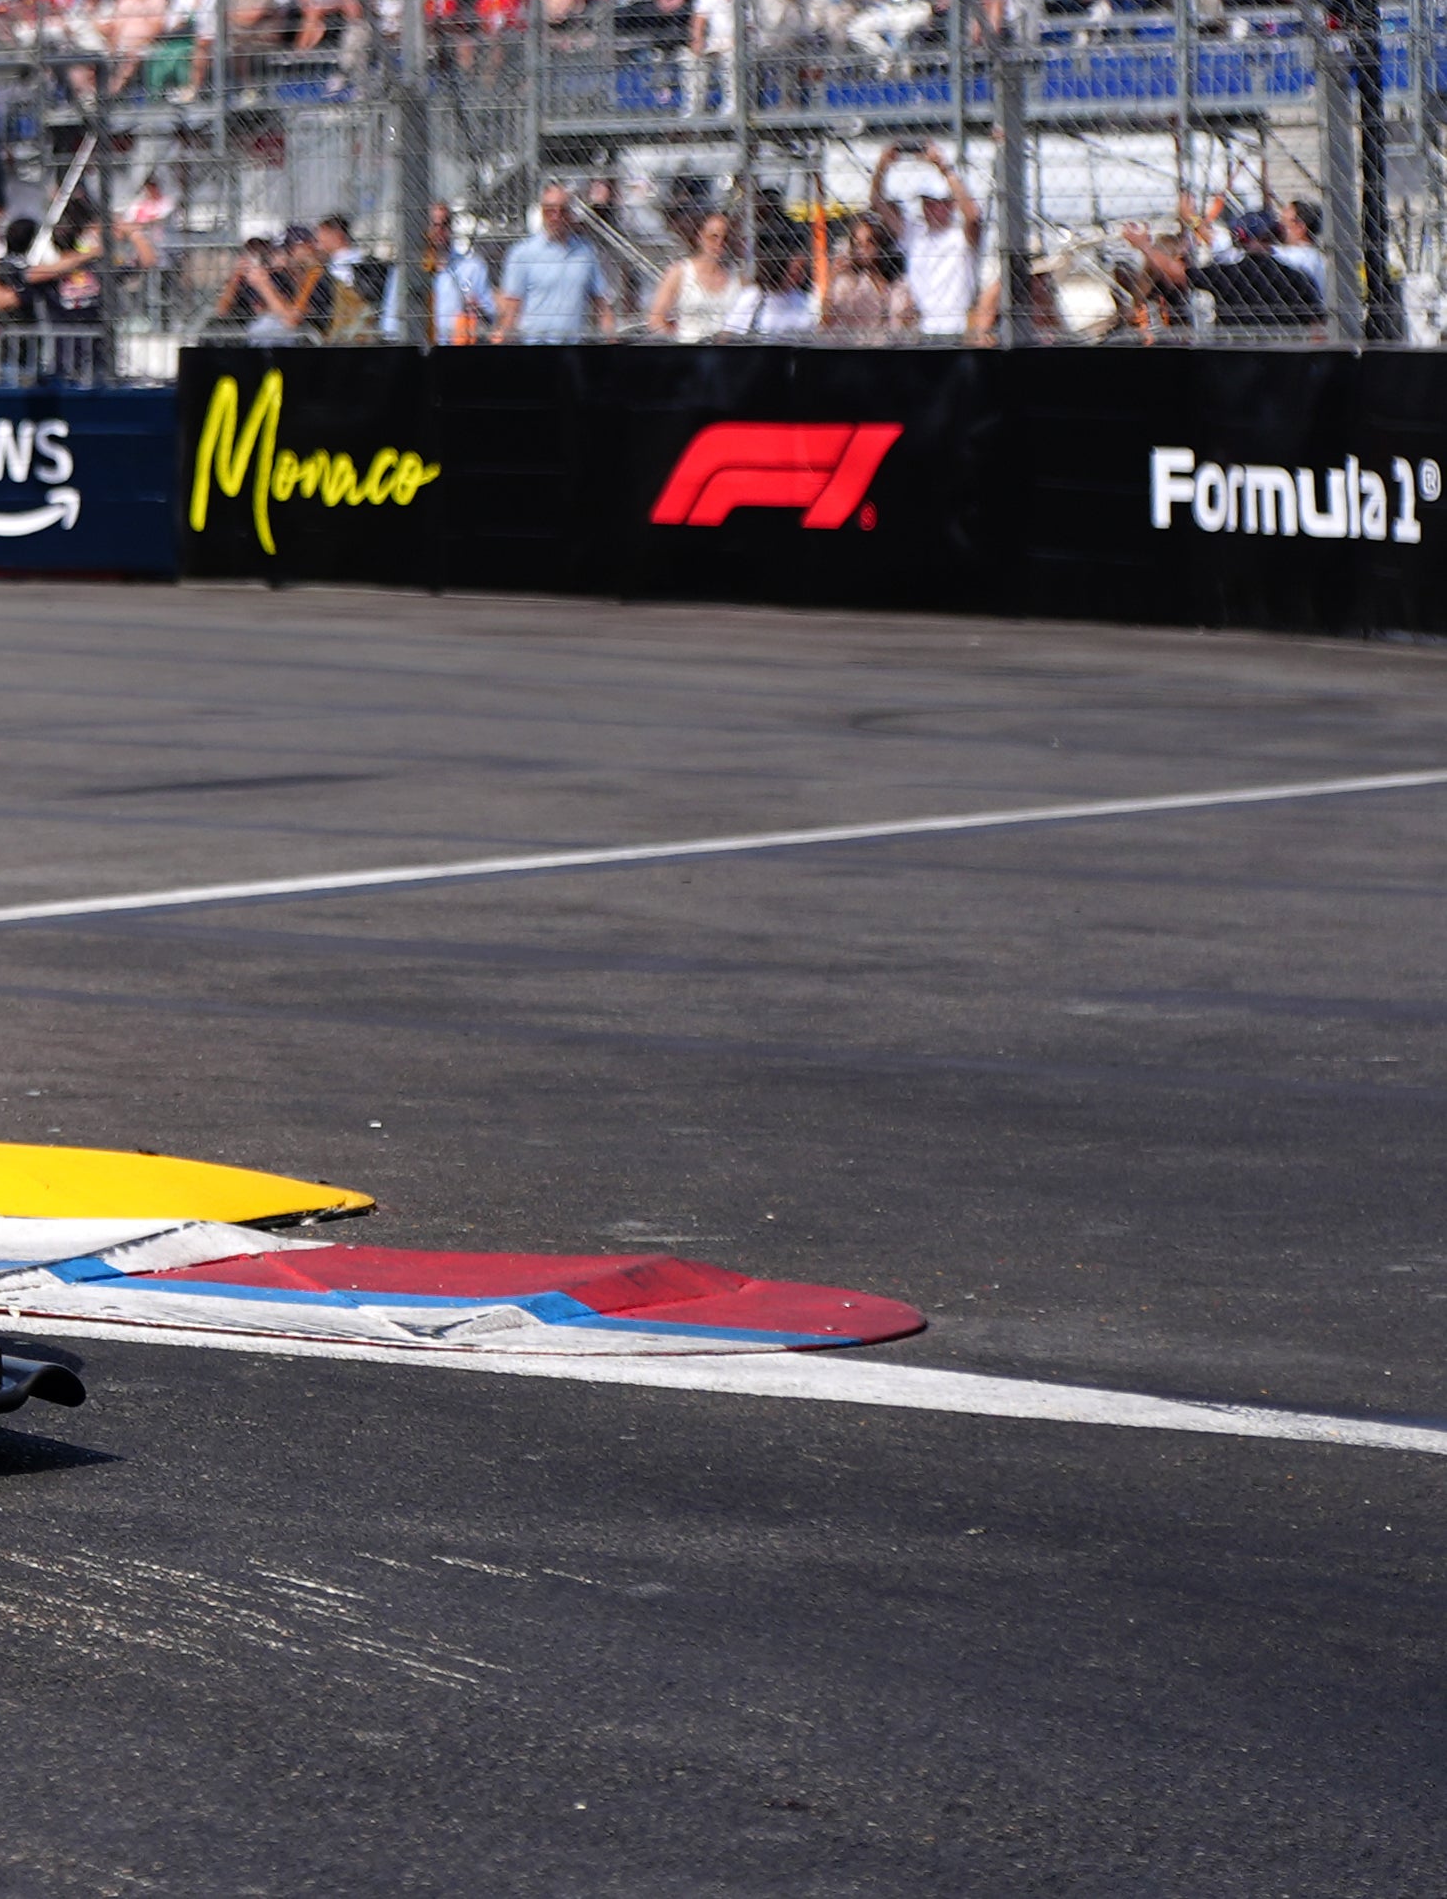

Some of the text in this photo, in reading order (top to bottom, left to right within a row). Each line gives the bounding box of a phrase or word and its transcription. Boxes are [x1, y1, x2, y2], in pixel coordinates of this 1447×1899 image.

[190, 368, 441, 555] Monaco
[650, 422, 905, 529] F1
[1149, 445, 1388, 542] Formula
